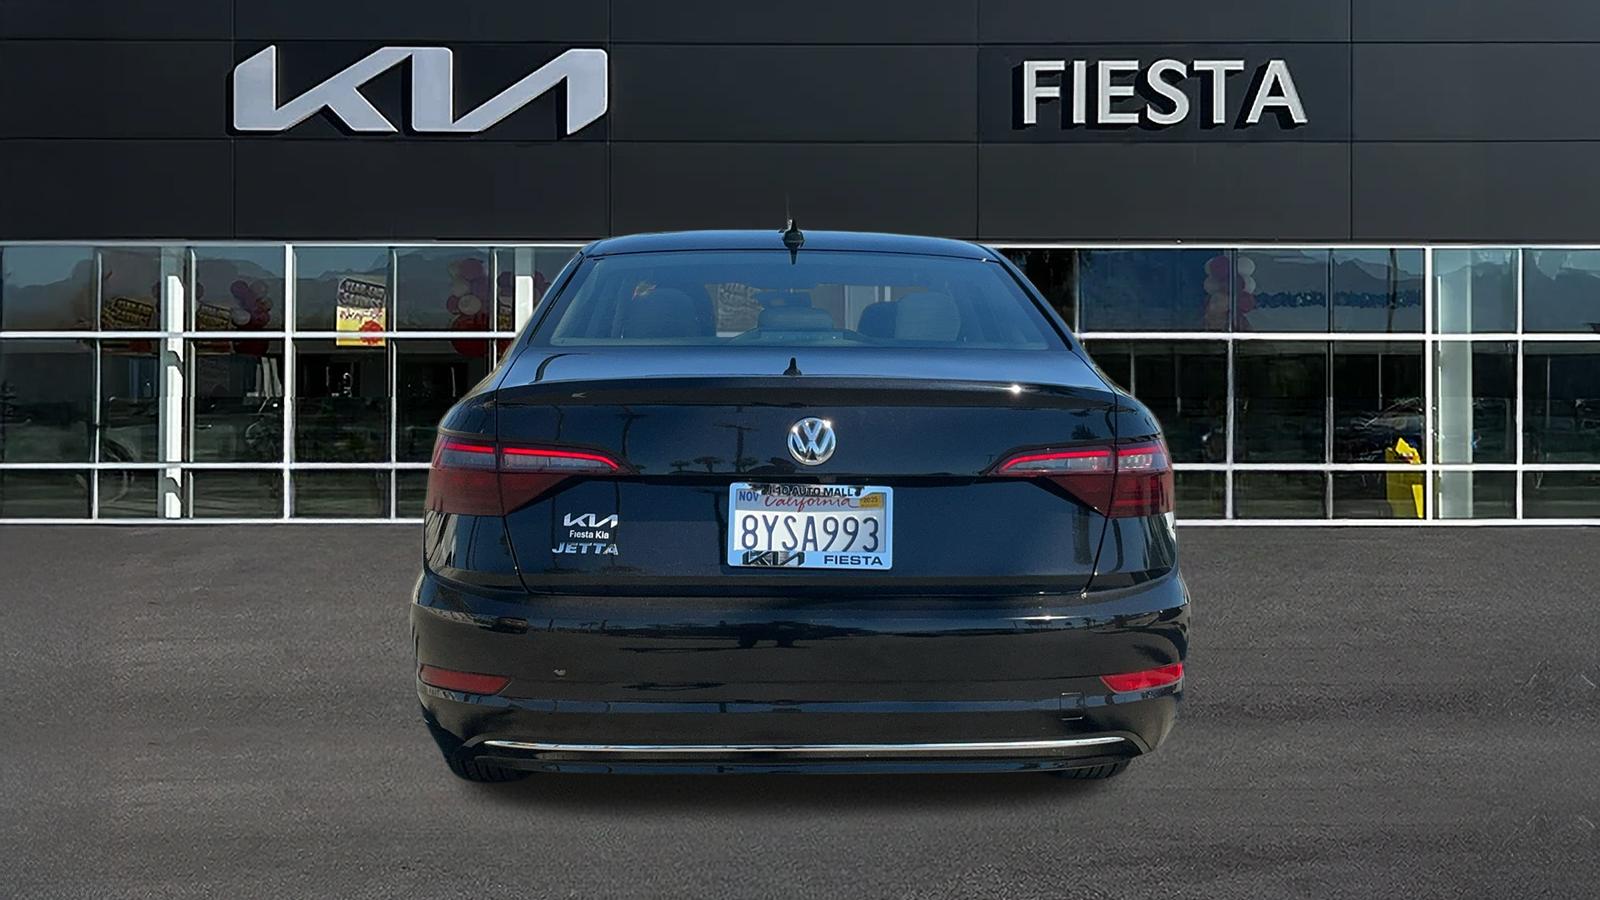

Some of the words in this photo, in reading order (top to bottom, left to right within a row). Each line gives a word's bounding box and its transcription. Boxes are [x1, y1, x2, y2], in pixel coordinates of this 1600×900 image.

[234, 45, 608, 135] KIA
[1022, 59, 1308, 125] FIESTA
[738, 491, 759, 502] NOV
[792, 486, 821, 497] AUTO
[823, 487, 854, 497] MALL
[764, 495, 858, 512] California
[569, 530, 594, 539] Fiesta
[595, 530, 609, 539] Kia
[741, 514, 880, 552] 8YSA993
[551, 542, 619, 556] JETTA
[824, 555, 883, 566] FIESTA
